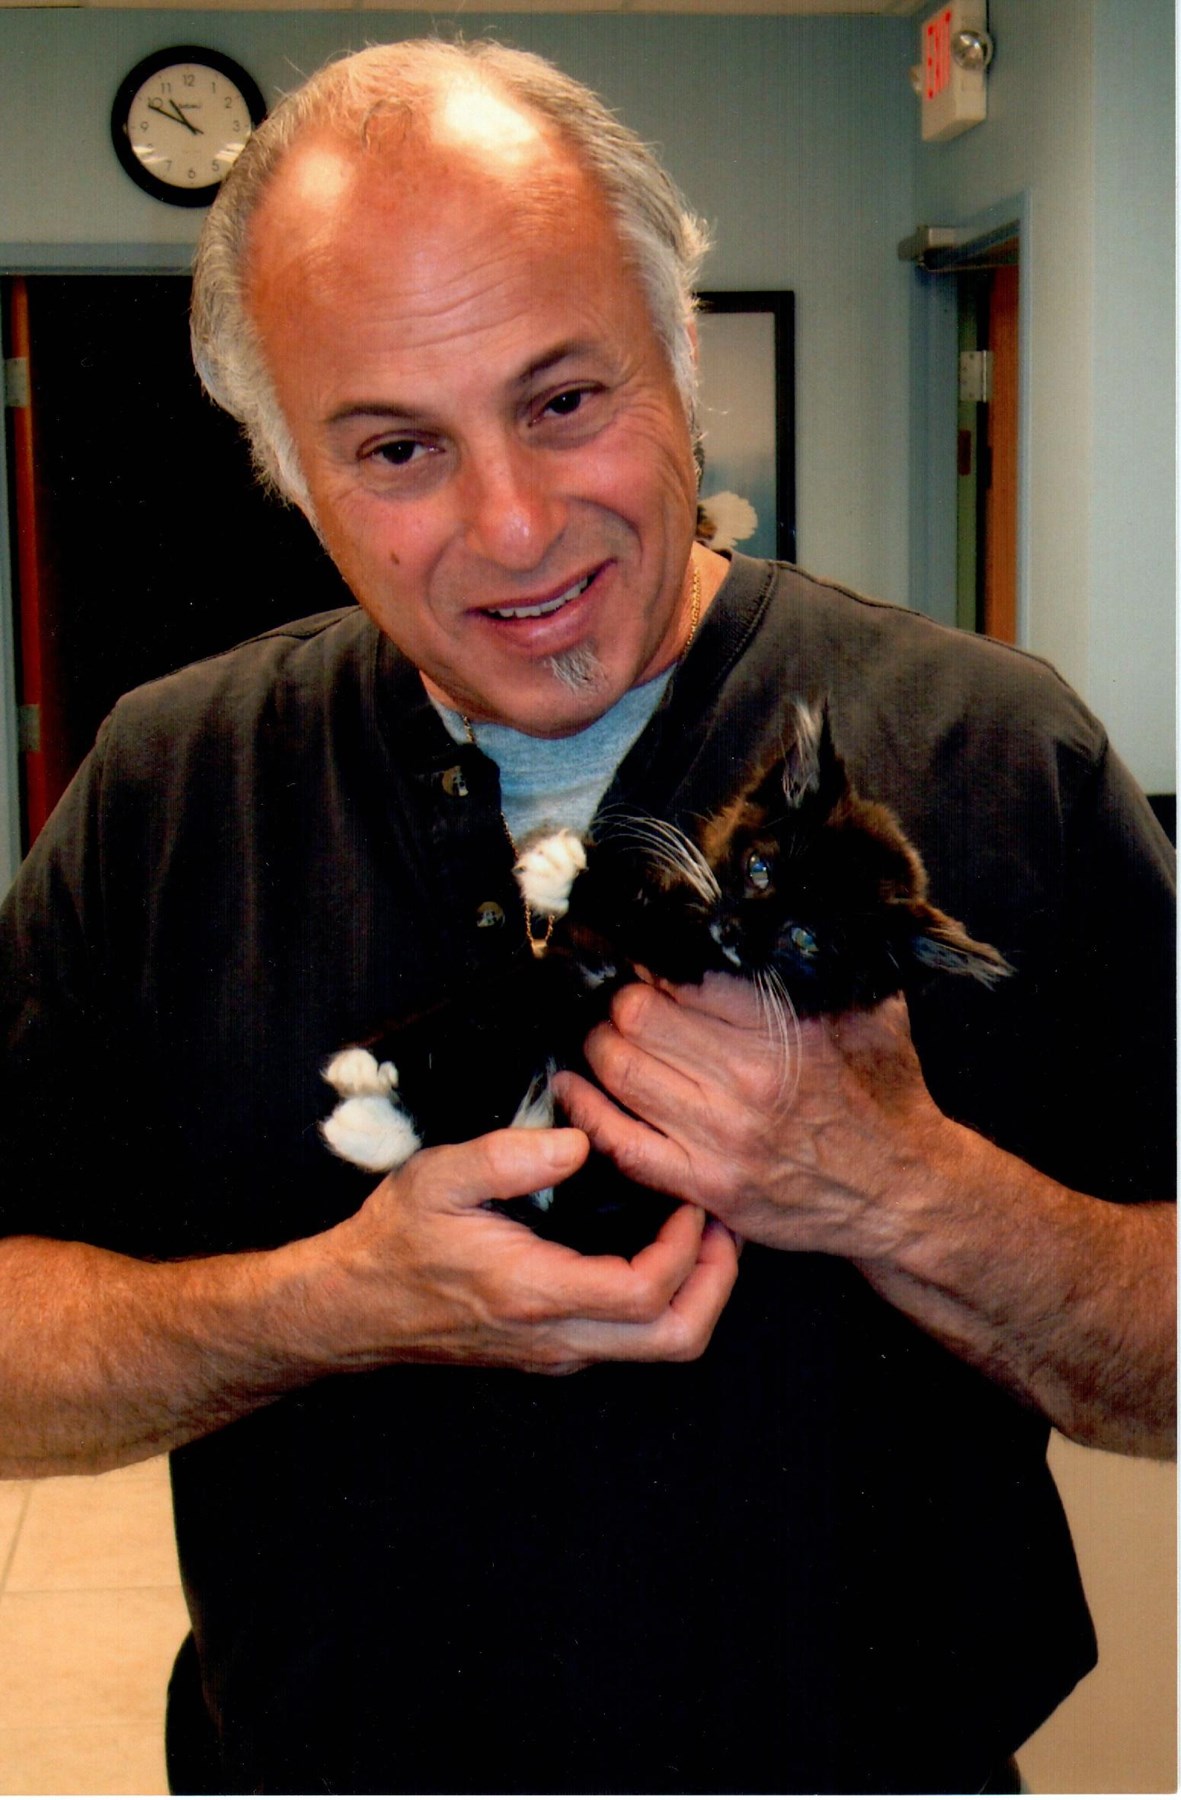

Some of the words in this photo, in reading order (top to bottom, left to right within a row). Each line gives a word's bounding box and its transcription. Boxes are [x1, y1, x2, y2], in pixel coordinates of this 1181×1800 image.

[925, 10, 952, 100] EXIT
[183, 74, 195, 86] 12
[161, 83, 172, 93] 11
[211, 82, 216, 93] 1
[225, 98, 232, 108] 2
[140, 121, 149, 131] 9
[233, 121, 240, 131] 3
[165, 160, 172, 171] 7
[212, 160, 220, 171] 5
[188, 168, 196, 179] 6
